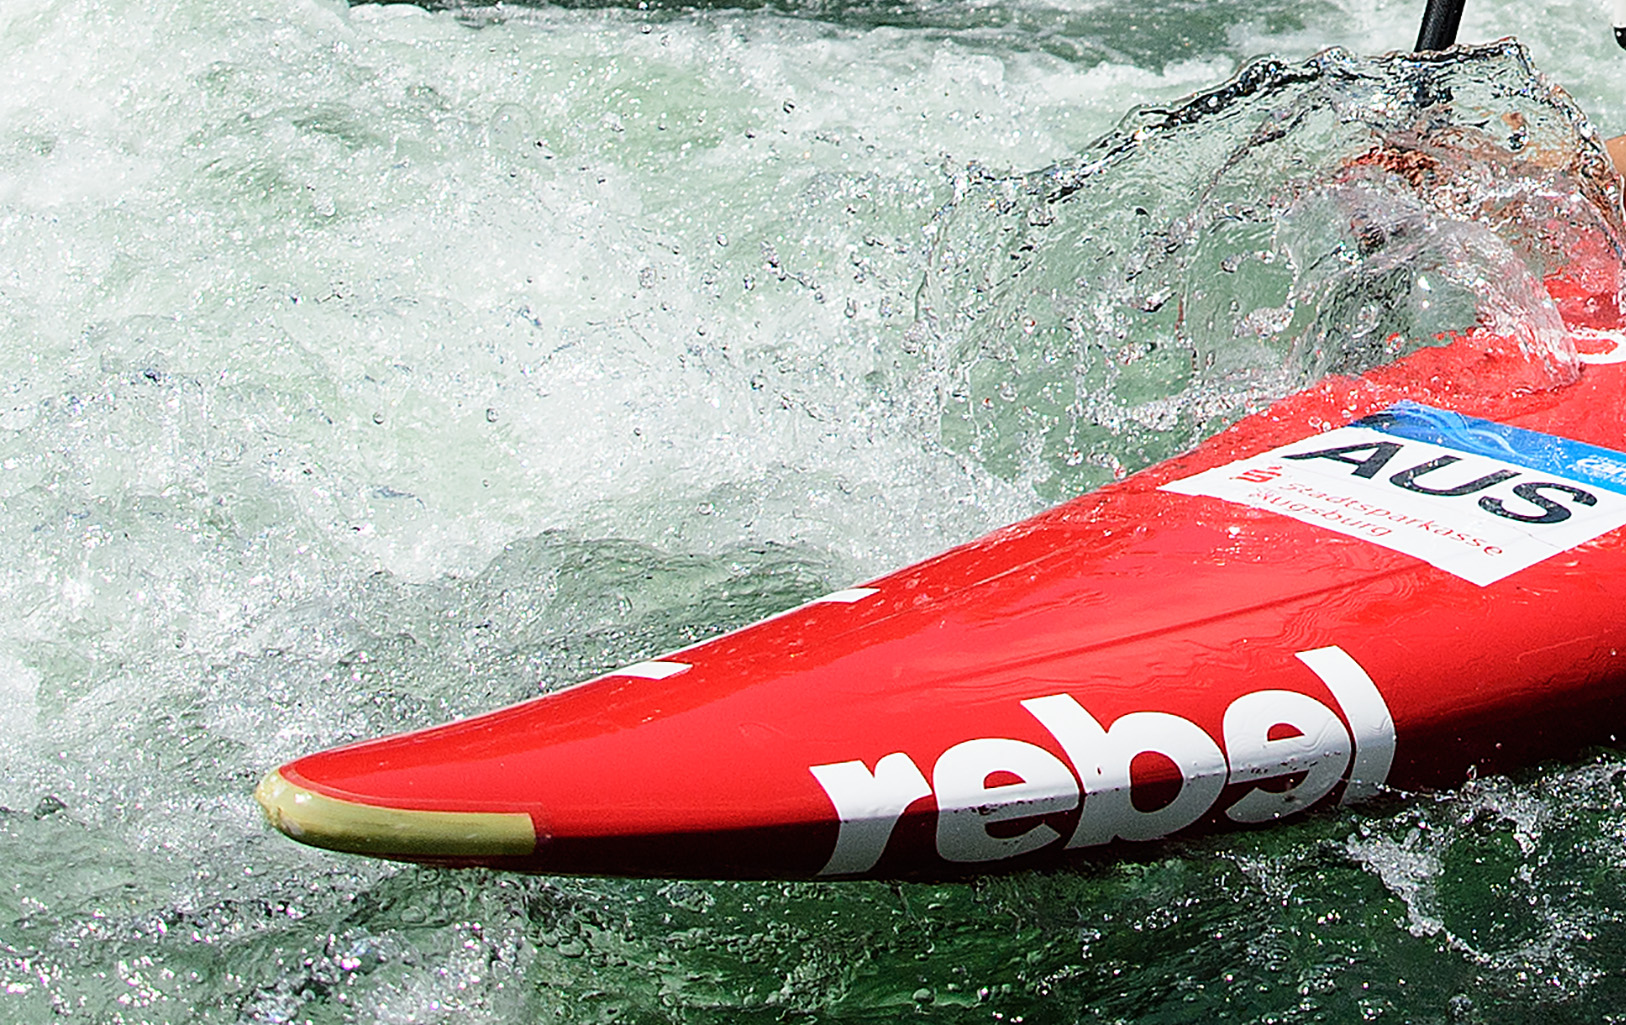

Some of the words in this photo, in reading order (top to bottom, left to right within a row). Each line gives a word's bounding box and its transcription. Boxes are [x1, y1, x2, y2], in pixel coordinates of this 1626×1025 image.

[1280, 483, 1503, 557] Stadtsparkasse
[1282, 441, 1598, 524] AUS
[809, 645, 1396, 875] rebel
